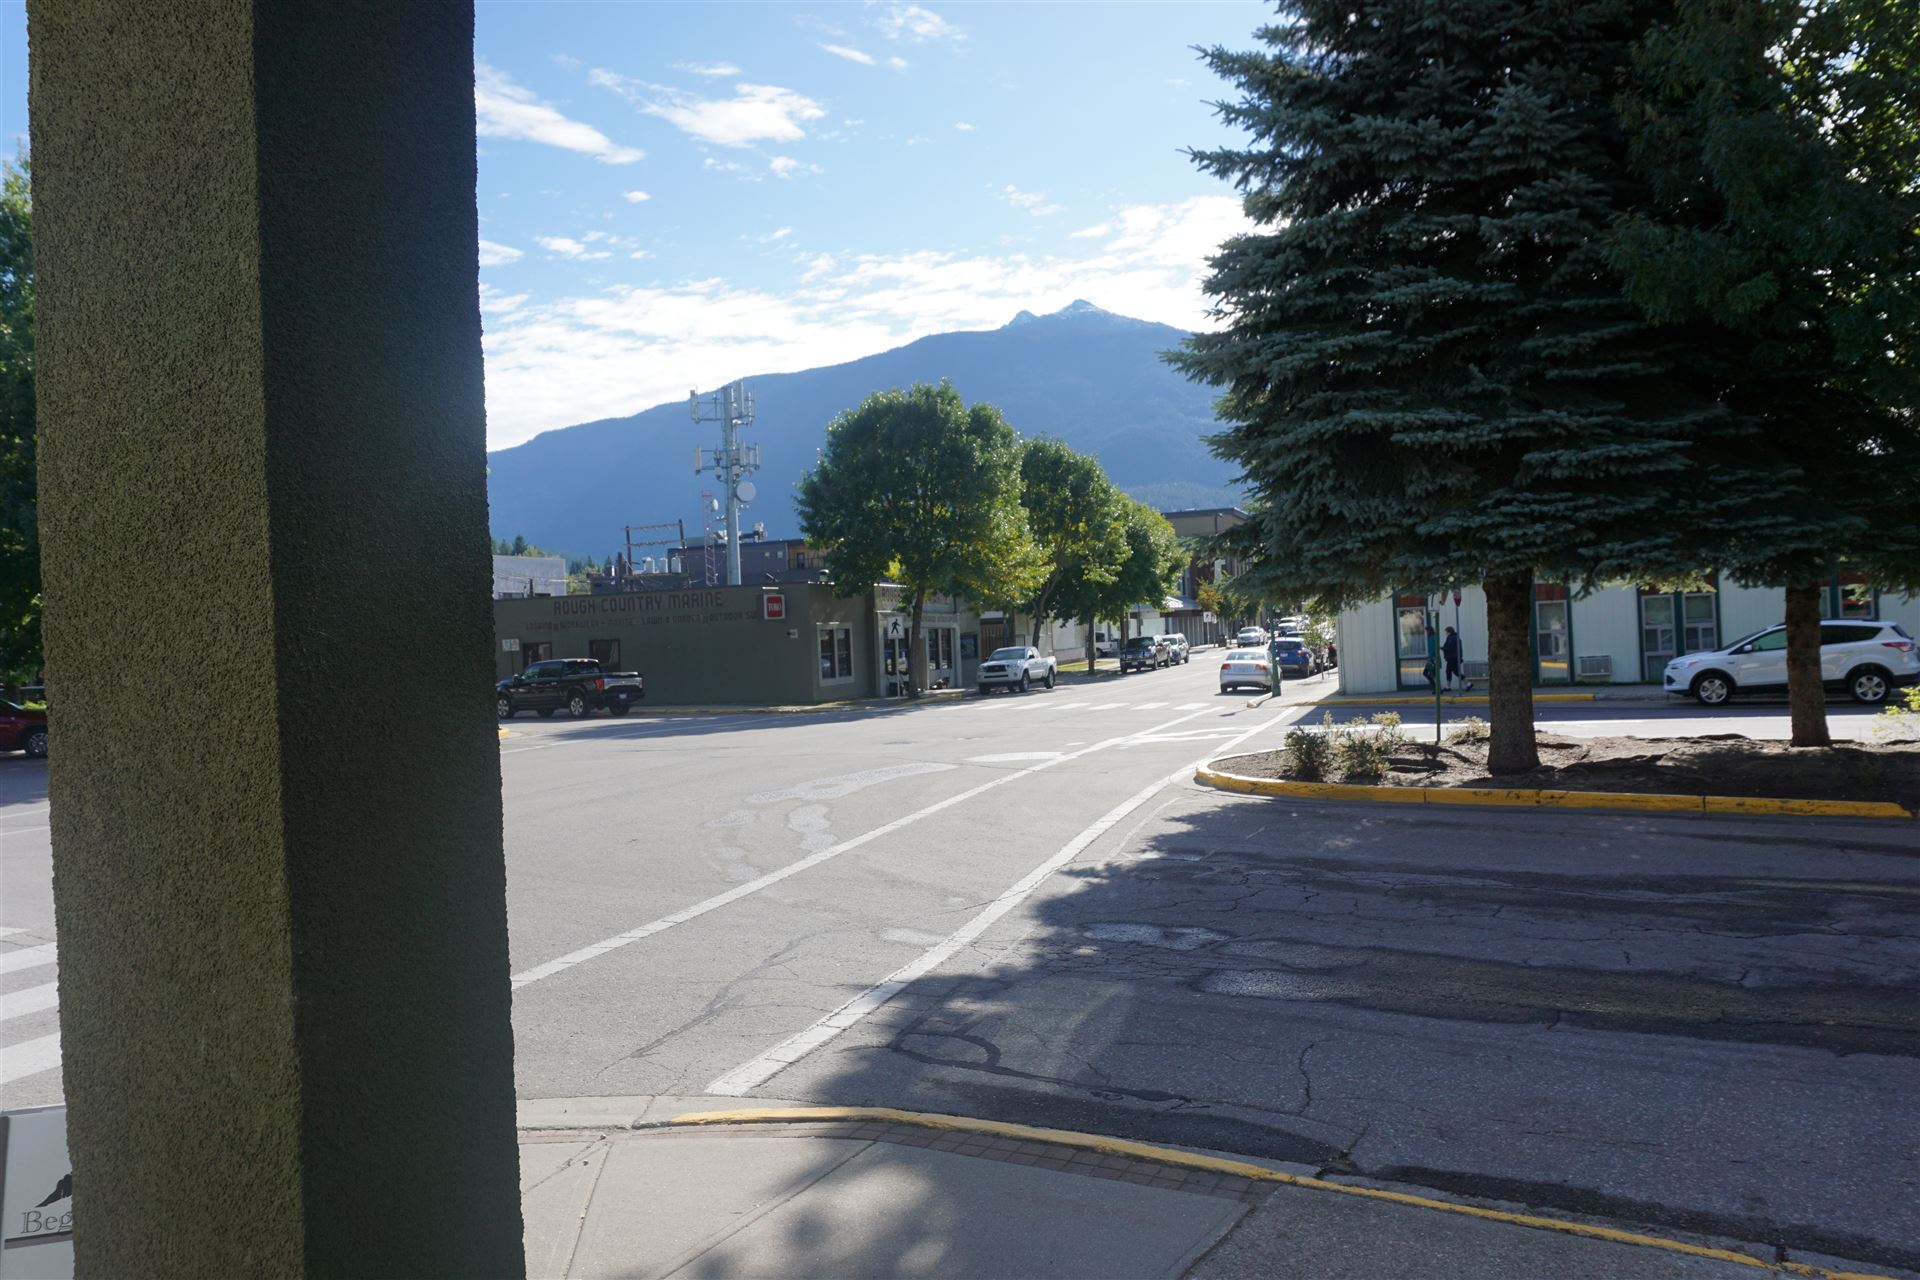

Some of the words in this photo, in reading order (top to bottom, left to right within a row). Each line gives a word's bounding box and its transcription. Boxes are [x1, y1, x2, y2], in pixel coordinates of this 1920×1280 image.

[553, 599, 596, 616] ROUGH
[601, 594, 662, 613] COUNTRY
[668, 591, 723, 609] MARINE
